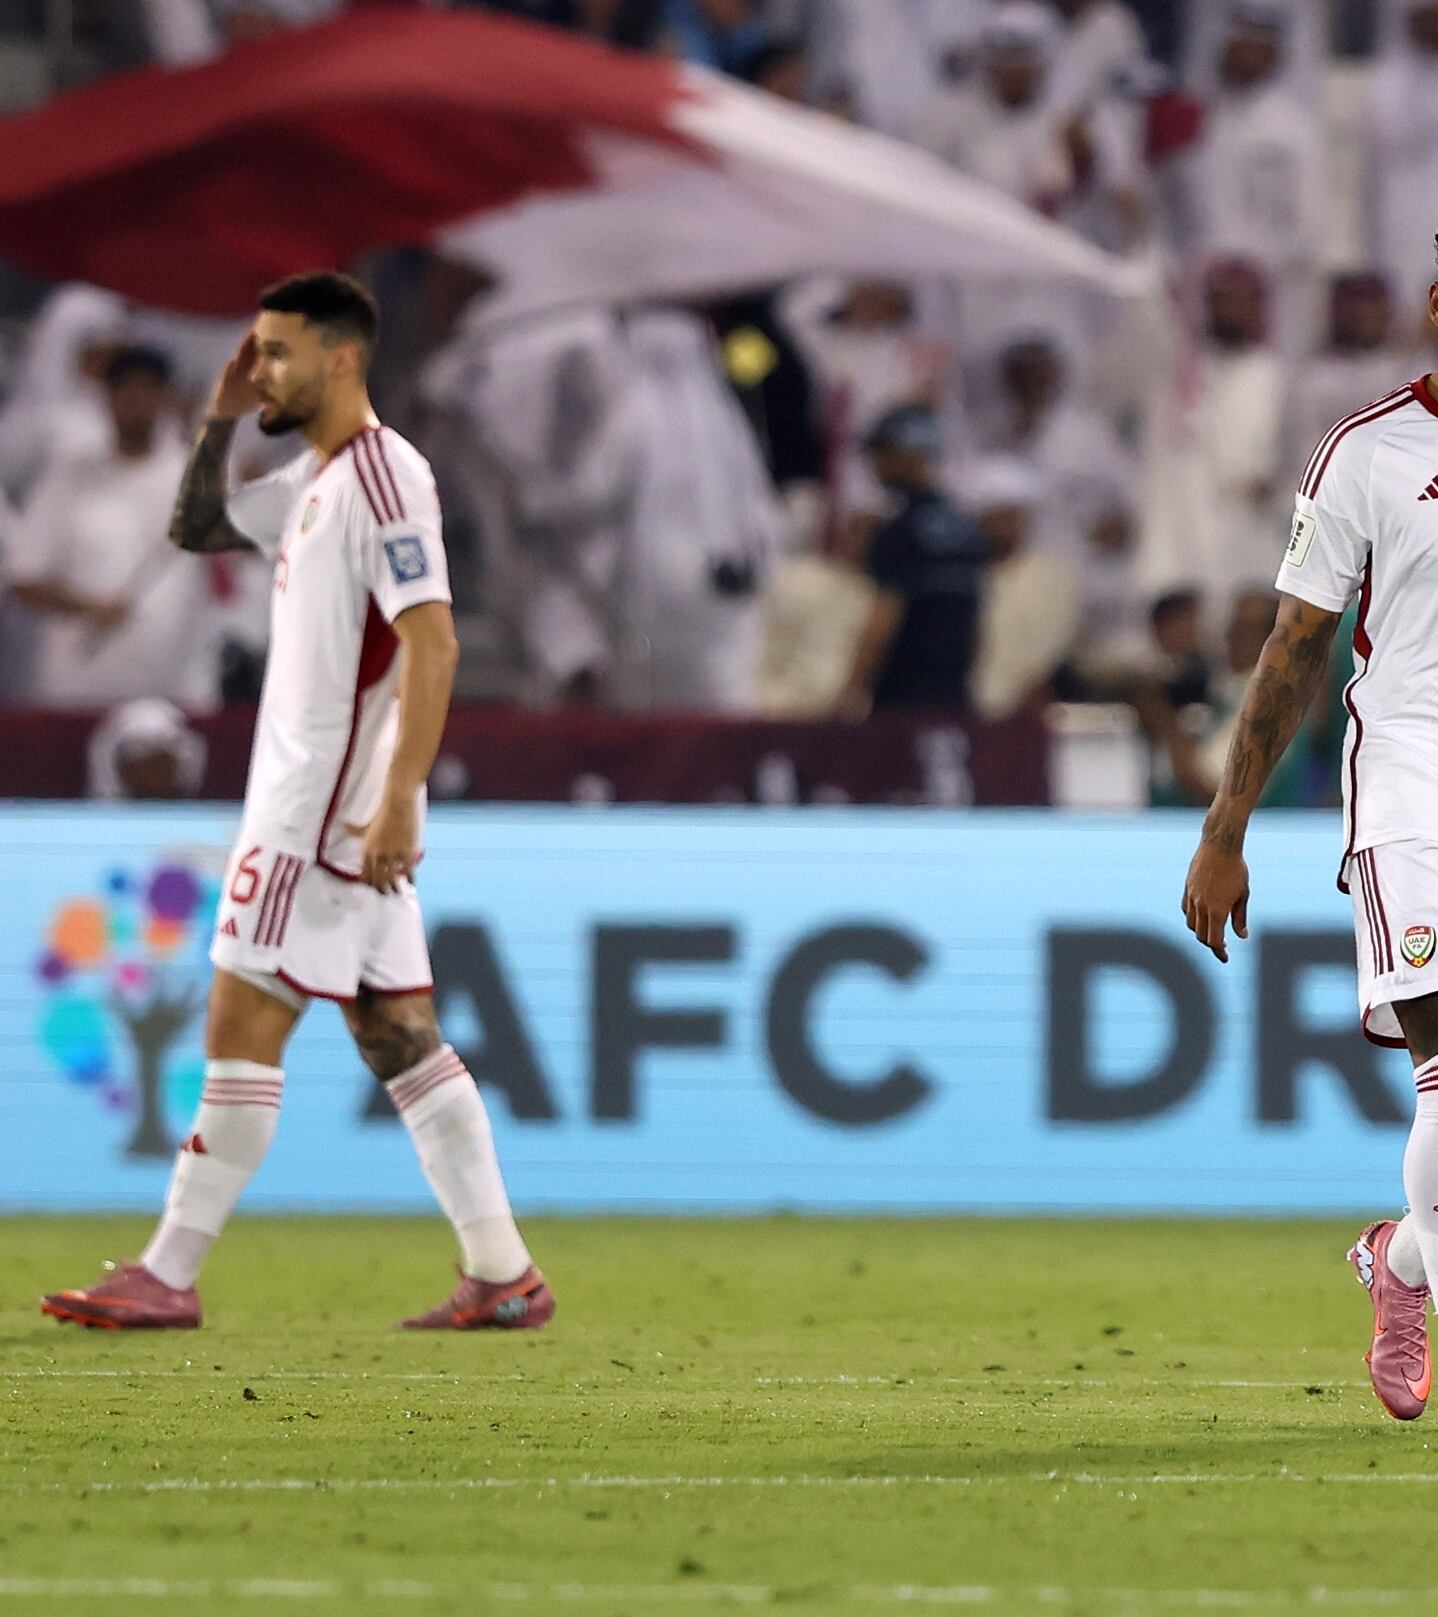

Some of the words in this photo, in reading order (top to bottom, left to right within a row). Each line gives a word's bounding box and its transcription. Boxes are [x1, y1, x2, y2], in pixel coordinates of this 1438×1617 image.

[230, 846, 261, 903] 6
[1408, 936, 1426, 944] UAE
[358, 918, 936, 1126] AFC
